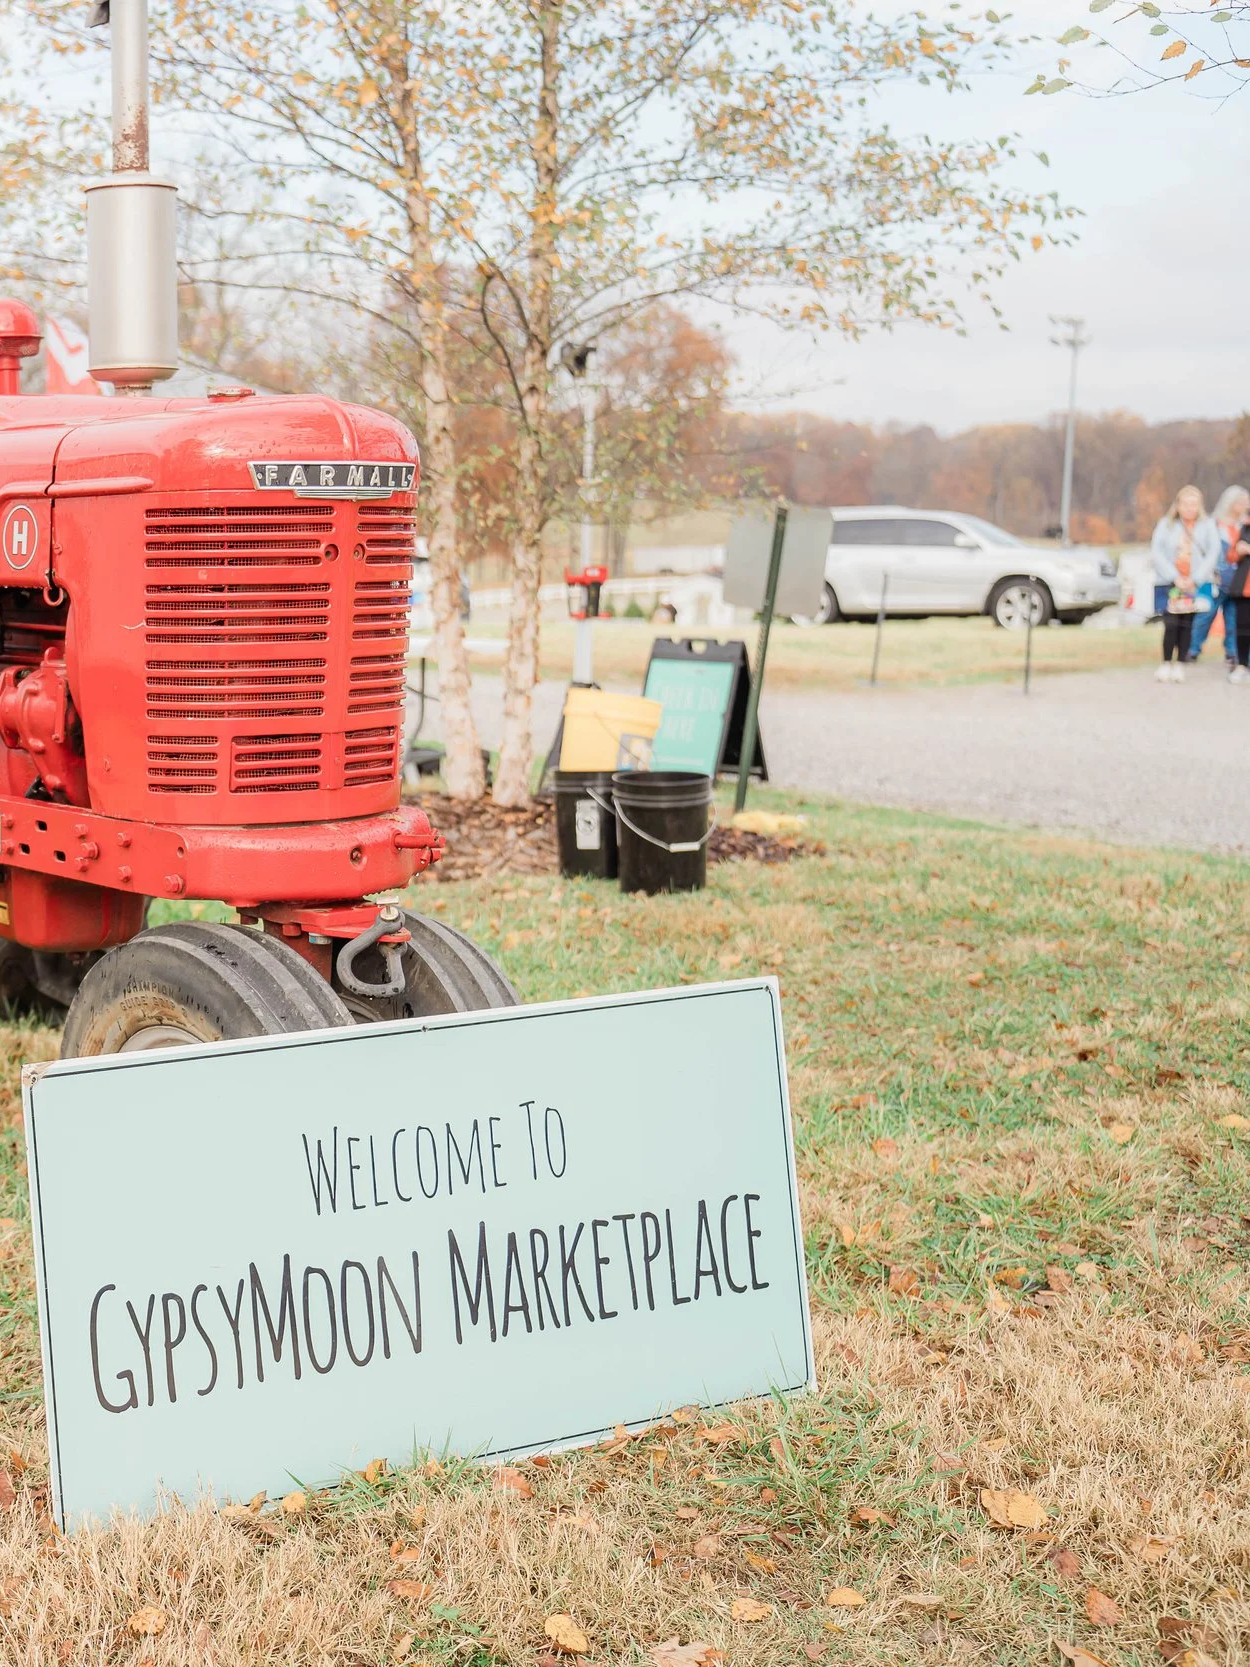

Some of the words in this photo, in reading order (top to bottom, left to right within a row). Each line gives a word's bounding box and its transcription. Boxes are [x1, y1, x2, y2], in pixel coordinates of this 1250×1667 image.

[265, 464, 409, 487] FARMALL
[12, 520, 29, 555] H
[119, 995, 149, 1012] GUIDE
